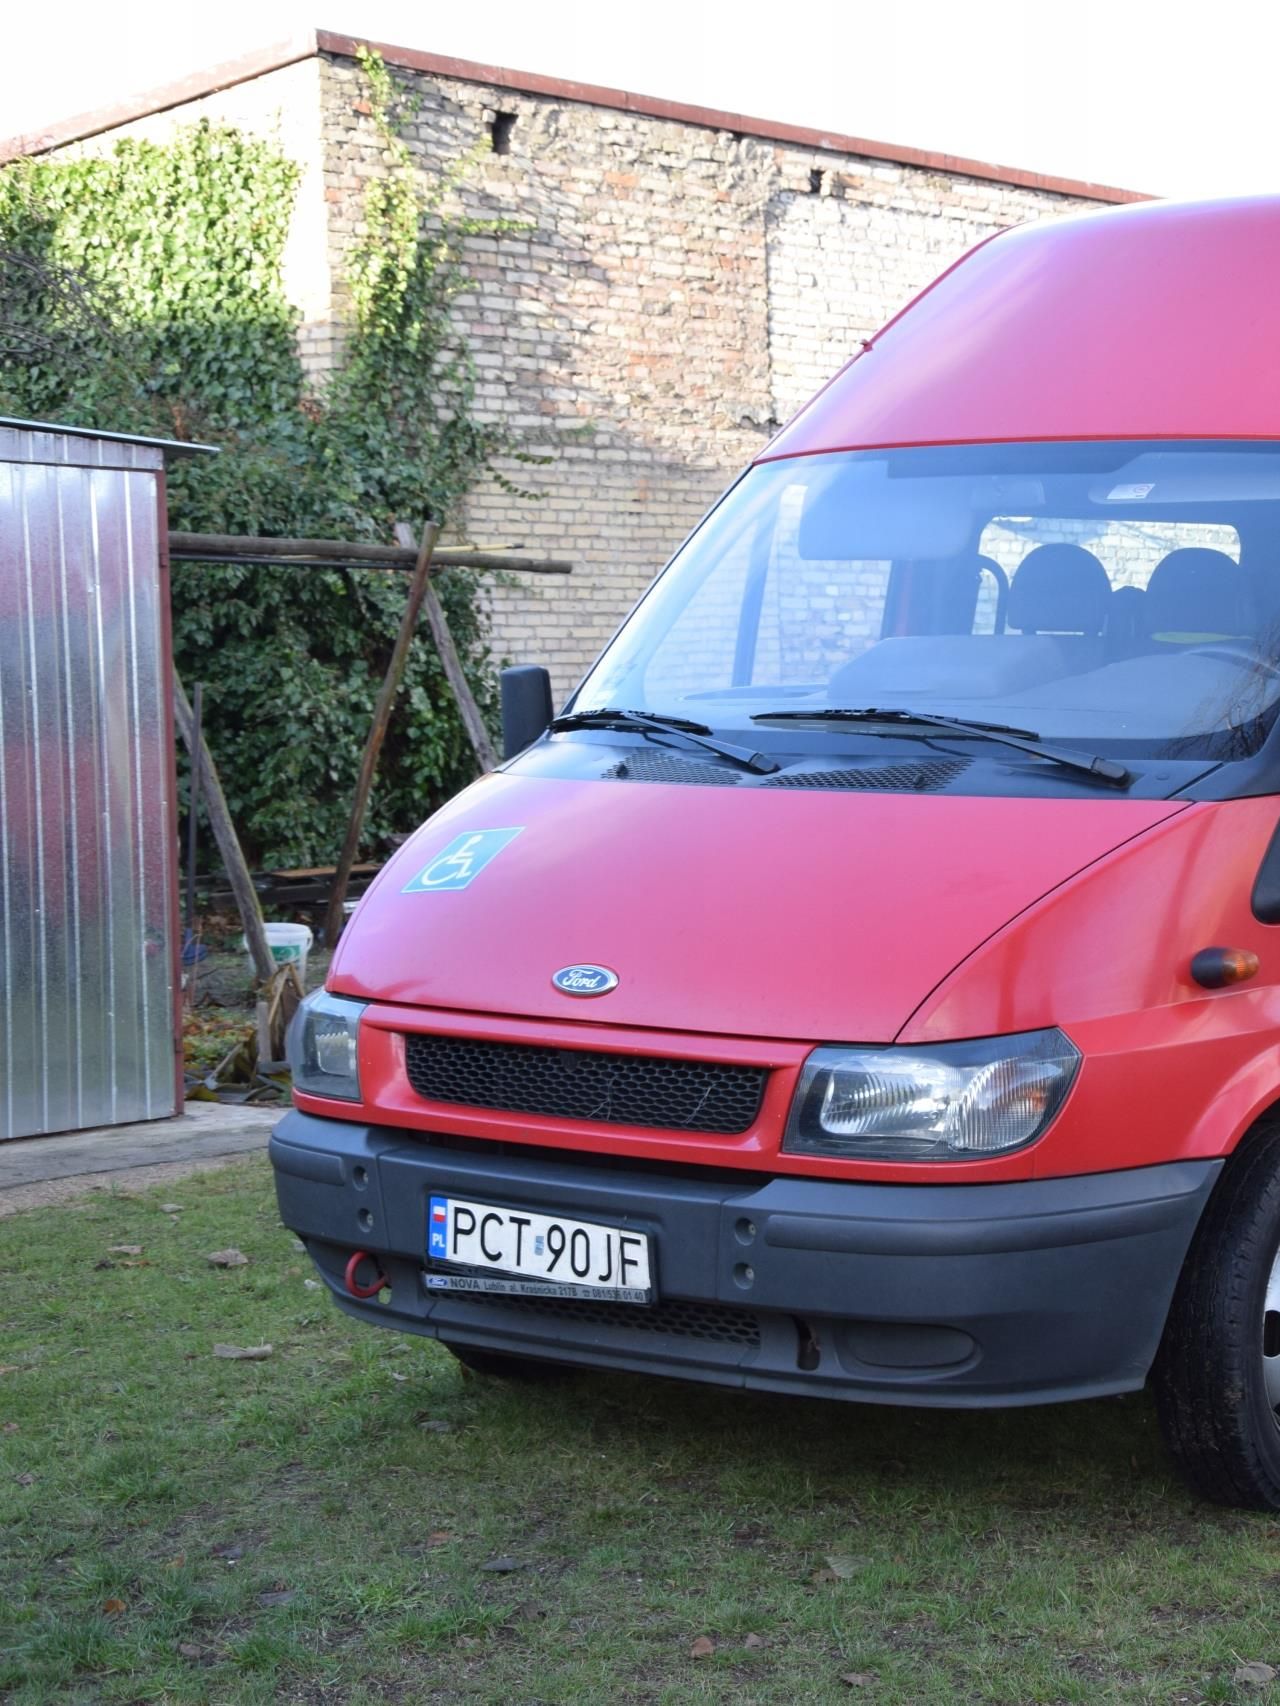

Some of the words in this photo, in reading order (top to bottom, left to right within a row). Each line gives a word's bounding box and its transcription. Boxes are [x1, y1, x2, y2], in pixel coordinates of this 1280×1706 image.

[562, 969, 601, 987] Ford
[432, 1232, 445, 1248] PL
[453, 1206, 531, 1267] PCT
[546, 1223, 641, 1286] 90JF
[450, 1278, 480, 1289] NOVA
[484, 1280, 506, 1291] Lublin
[558, 1286, 578, 1297] 217B
